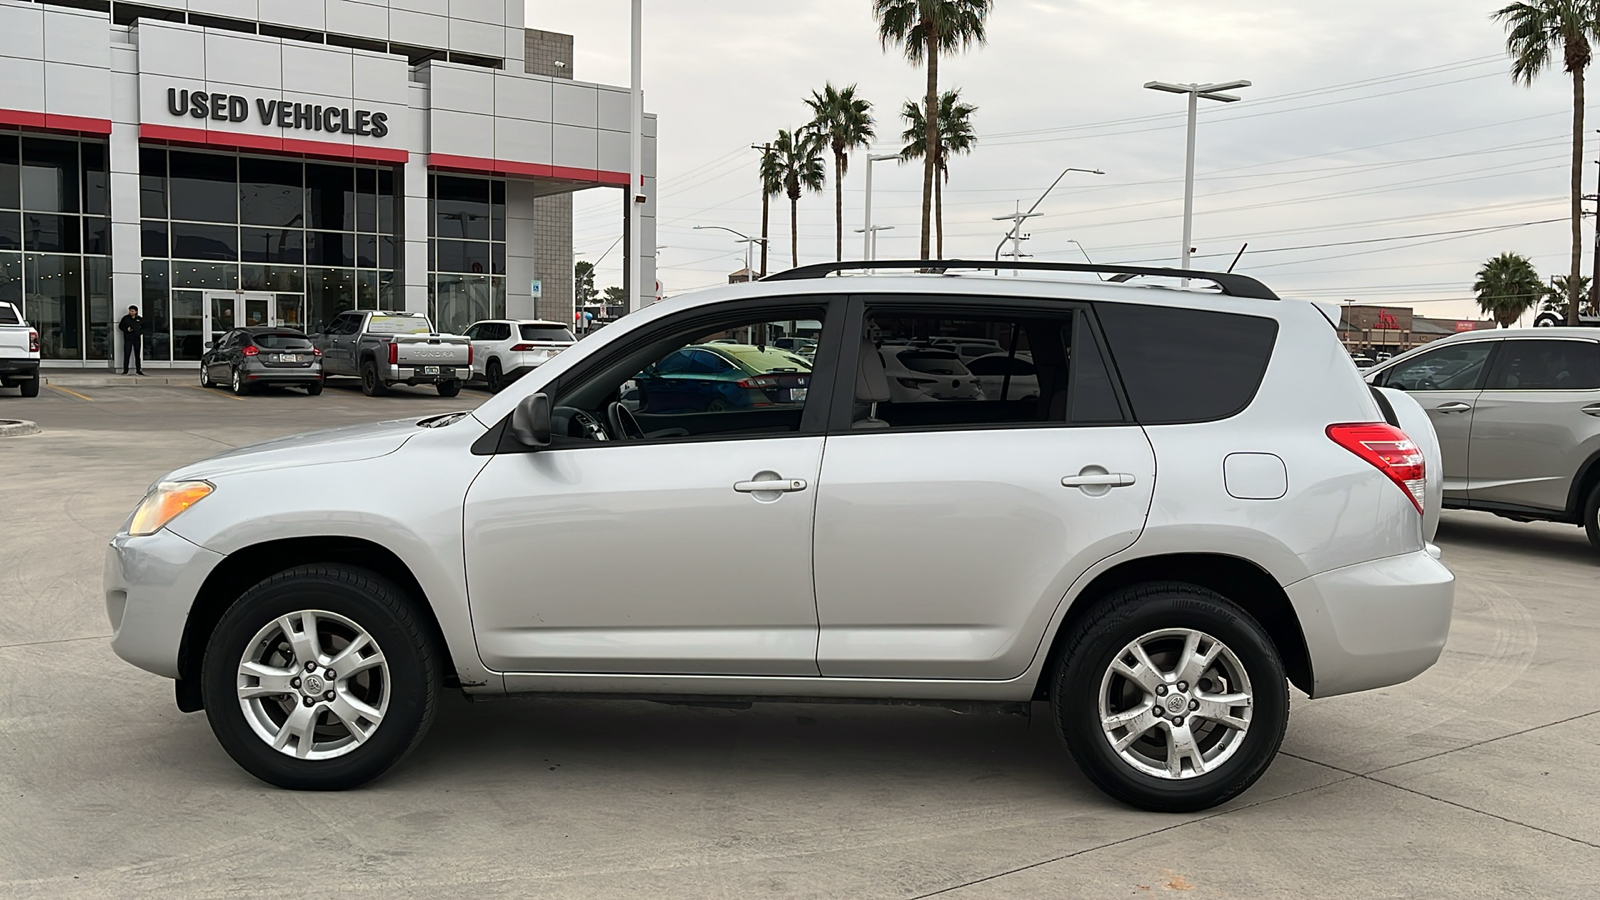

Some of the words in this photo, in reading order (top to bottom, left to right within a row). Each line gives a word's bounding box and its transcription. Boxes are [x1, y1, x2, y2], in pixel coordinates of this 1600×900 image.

[167, 87, 249, 123] USED
[256, 98, 388, 138] VEHICLES
[413, 350, 455, 358] TUNDRA
